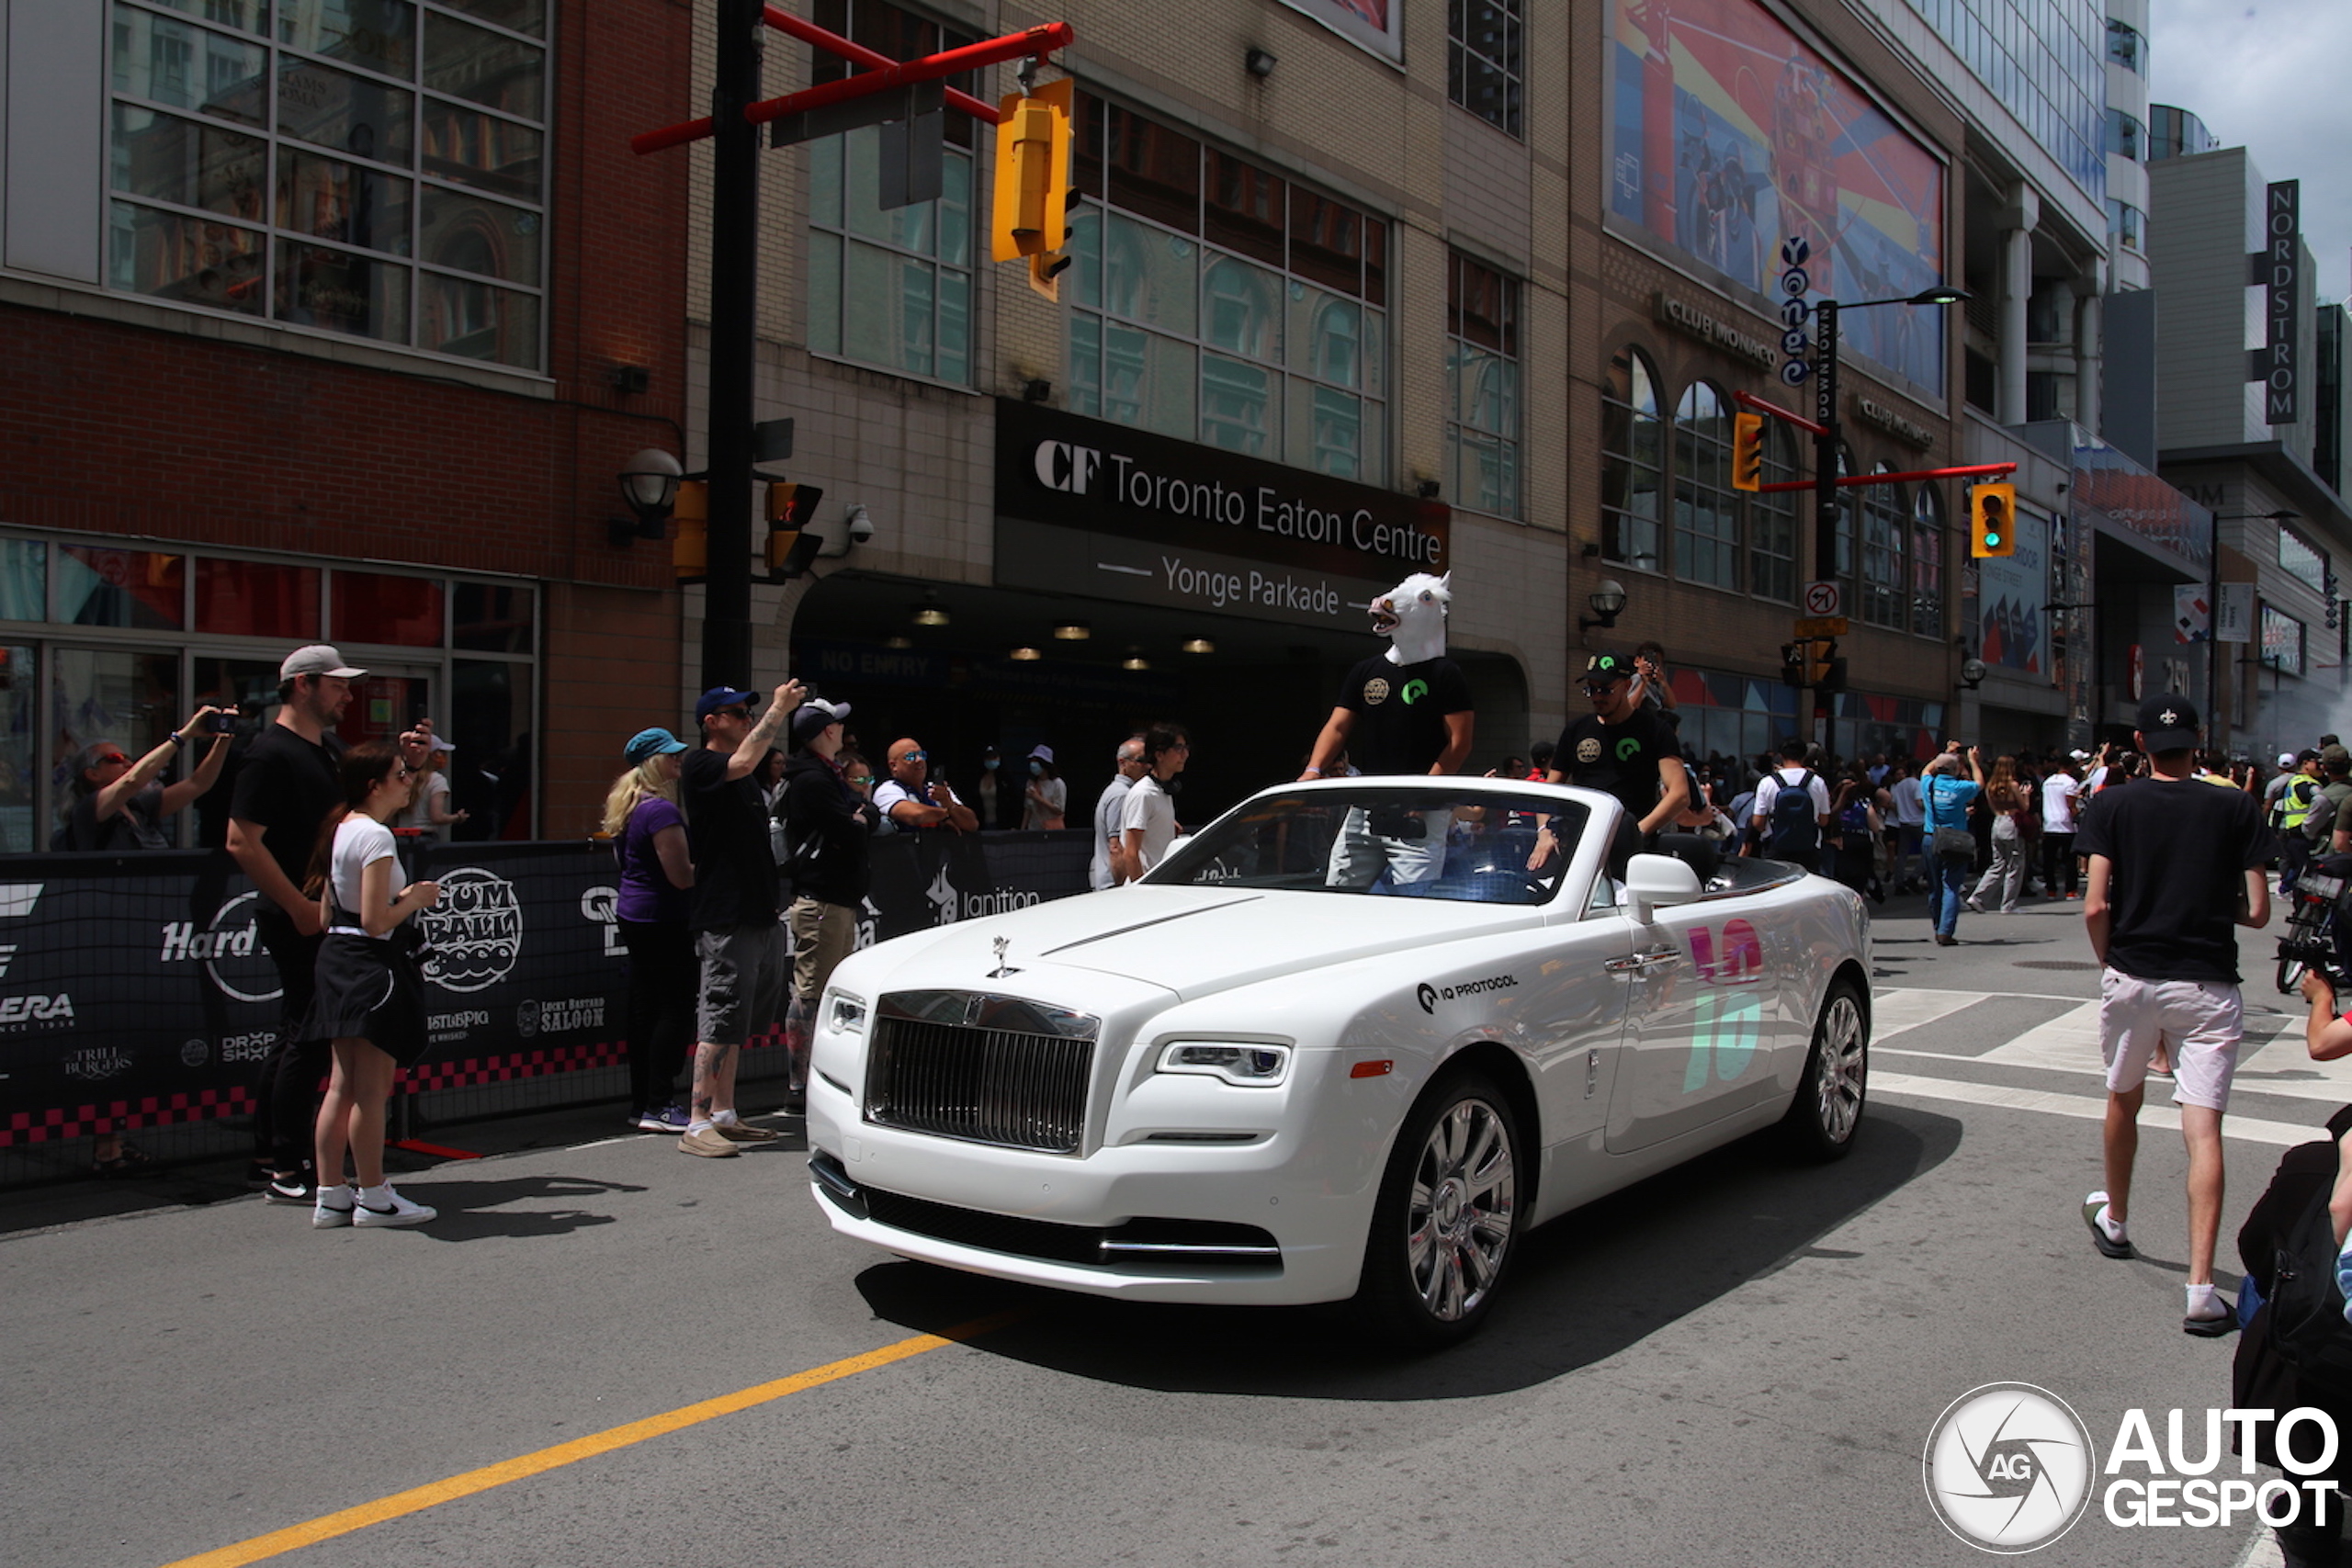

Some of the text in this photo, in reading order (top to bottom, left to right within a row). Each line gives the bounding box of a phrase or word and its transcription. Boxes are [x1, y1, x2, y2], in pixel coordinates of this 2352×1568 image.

[2270, 187, 2293, 414] NORDSTROM
[1668, 301, 1778, 367] CLUB MONACO
[1819, 308, 1830, 420] DOWNTOWN
[1862, 400, 1893, 424] CLUB
[1035, 438, 1442, 564] CF Toronto Eaton Centre
[1162, 556, 1340, 615] Yonge Parkade
[821, 650, 929, 677] NO ENTRY
[160, 918, 258, 962] Hard
[1442, 975, 1519, 1001] IQ PROTOCOL
[427, 1010, 490, 1031] ISTLEPIG
[540, 1007, 605, 1032] SALOON
